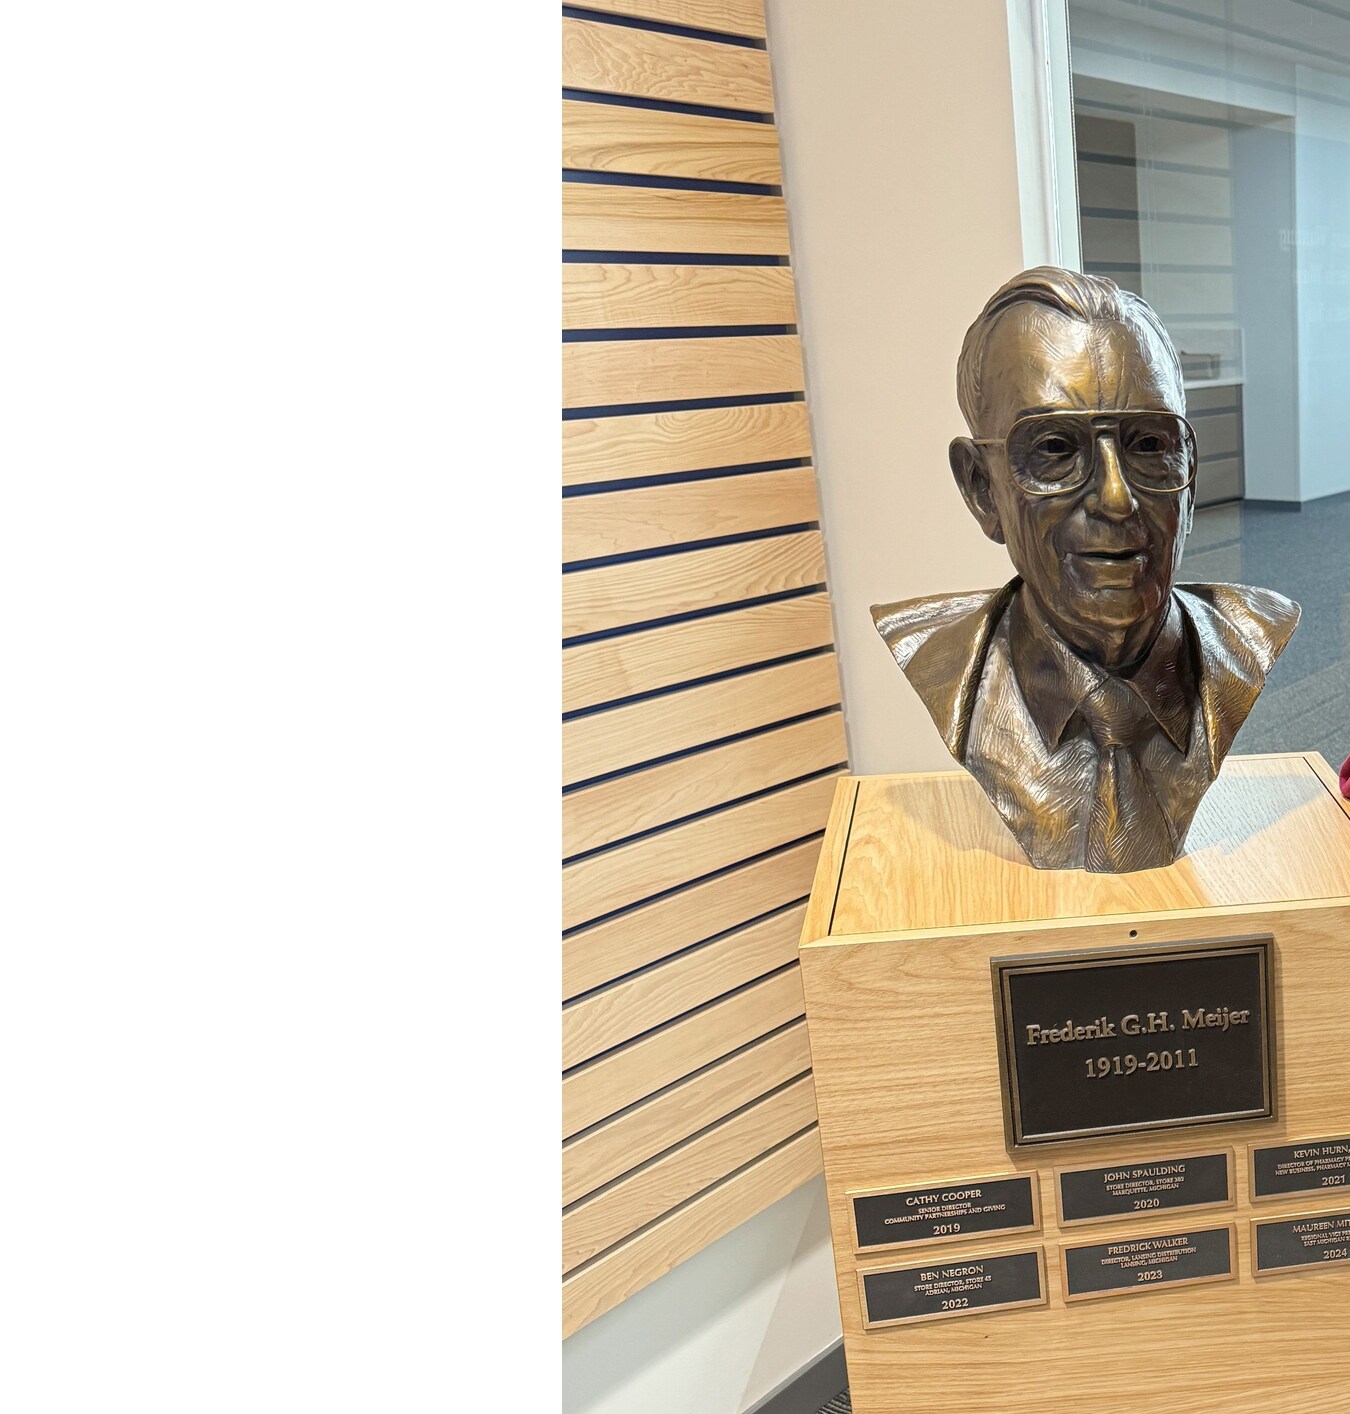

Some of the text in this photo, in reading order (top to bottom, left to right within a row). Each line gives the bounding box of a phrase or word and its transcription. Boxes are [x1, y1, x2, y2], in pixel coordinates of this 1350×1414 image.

[1120, 1011, 1175, 1036] G.H.
[1181, 1007, 1250, 1032] Meijer
[1085, 1048, 1199, 1079] 1919-2011
[1293, 1148, 1320, 1159] KEVIN
[1322, 1145, 1350, 1156] HURN,
[1277, 1161, 1305, 1170] DIRECTOR
[1314, 1156, 1345, 1166] PHARMACY
[1316, 1162, 1347, 1171] PHARMACY
[1103, 1164, 1186, 1183] JOHN SPAULDING
[1322, 1174, 1346, 1186] 2021
[1106, 1183, 1125, 1191] STORE
[1125, 1180, 1155, 1190] DIRECTOR,
[1155, 1178, 1174, 1186] STORE
[1149, 1183, 1180, 1192] MICHIGAN
[906, 1189, 982, 1206] CATHY COOPER
[1133, 1198, 1160, 1210] 2020
[884, 1214, 924, 1225] COMMUNITY
[924, 1209, 967, 1221] PARTNERSHIPS
[982, 1204, 1006, 1213] GIVING
[918, 1202, 972, 1214] SENIOR DIRECTOR
[933, 1223, 961, 1235] 2019
[1292, 1220, 1335, 1234] MAUREEN
[1301, 1232, 1329, 1242] REGIONAL
[1329, 1230, 1342, 1238] VICE
[1316, 1236, 1345, 1246] MICHIGAN
[1108, 1237, 1188, 1256] FREDRICK WALKER
[1131, 1252, 1157, 1261] LANSING
[1157, 1246, 1197, 1258] DISTRIBUTION
[1323, 1248, 1348, 1260] 2024
[1120, 1255, 1178, 1269] LANSING, MICHIGAN
[920, 1265, 984, 1282] BEN NEGRON
[1137, 1270, 1163, 1282] 2023
[914, 1283, 933, 1292] STORE
[933, 1280, 965, 1290] DIRECTOR,
[965, 1276, 984, 1285] STORE
[925, 1283, 983, 1297] ADRIAN, MICHIGAN
[941, 1297, 969, 1310] 2022
